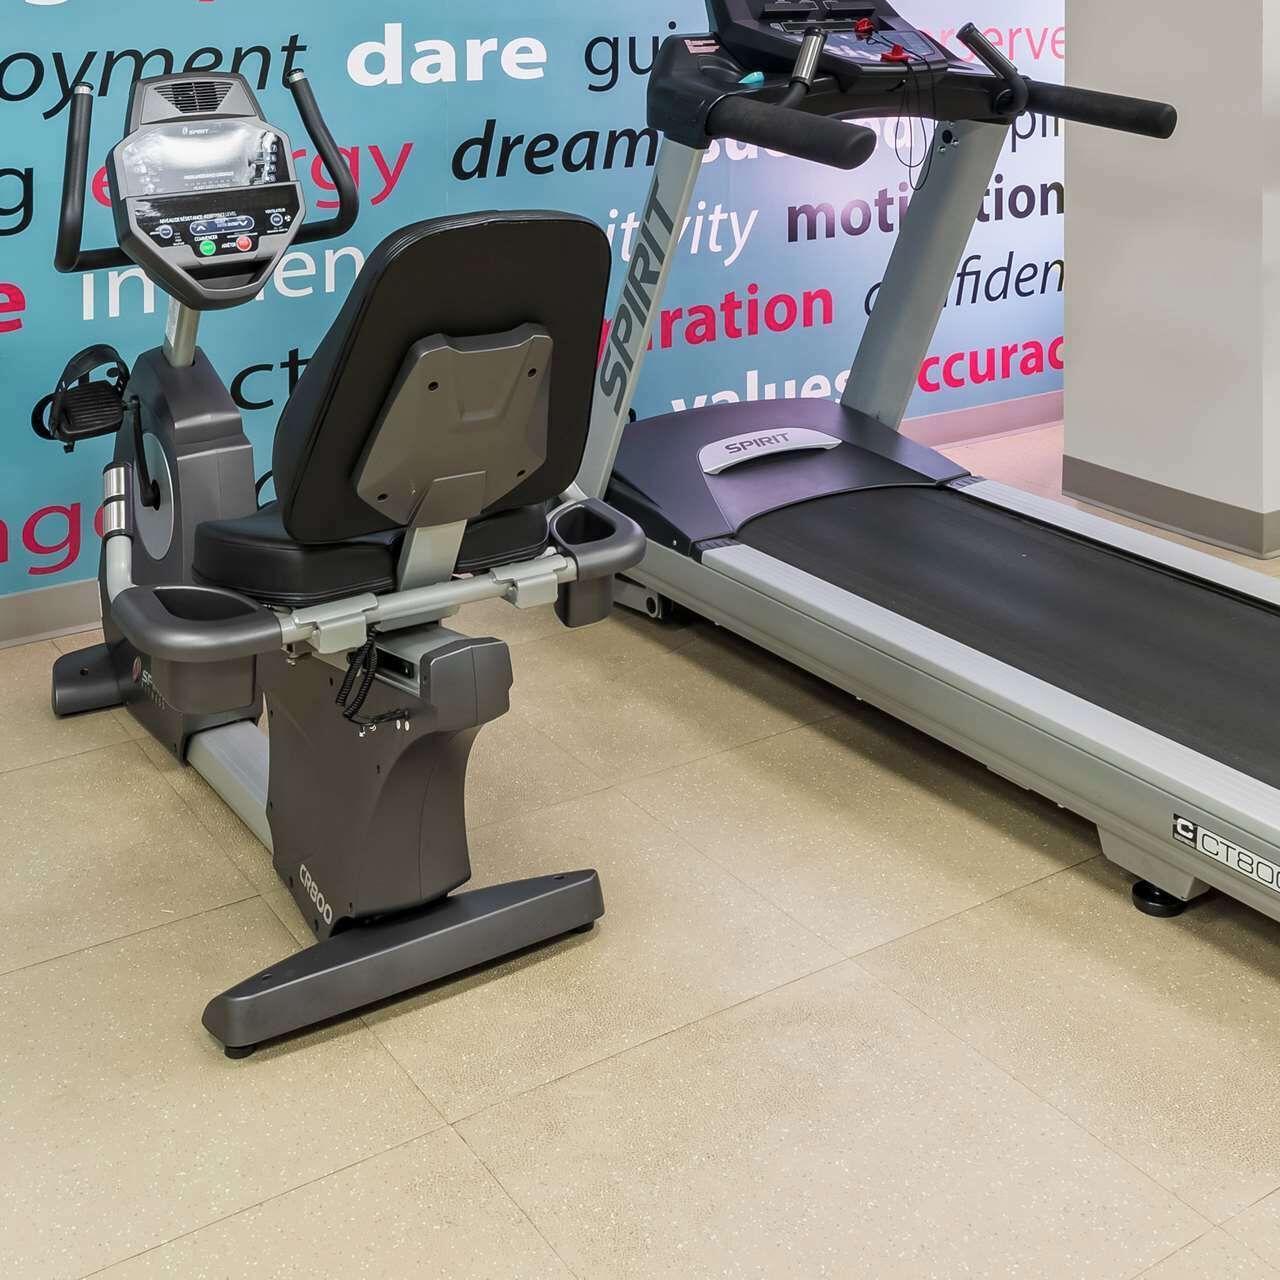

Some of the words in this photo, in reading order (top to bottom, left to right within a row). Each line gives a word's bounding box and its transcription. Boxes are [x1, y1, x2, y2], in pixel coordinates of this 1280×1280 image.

[346, 23, 548, 87] dare
[451, 119, 660, 181] dream
[599, 173, 676, 417] SPIRIT
[724, 432, 792, 455] SPIRIT
[298, 863, 334, 926] CR800
